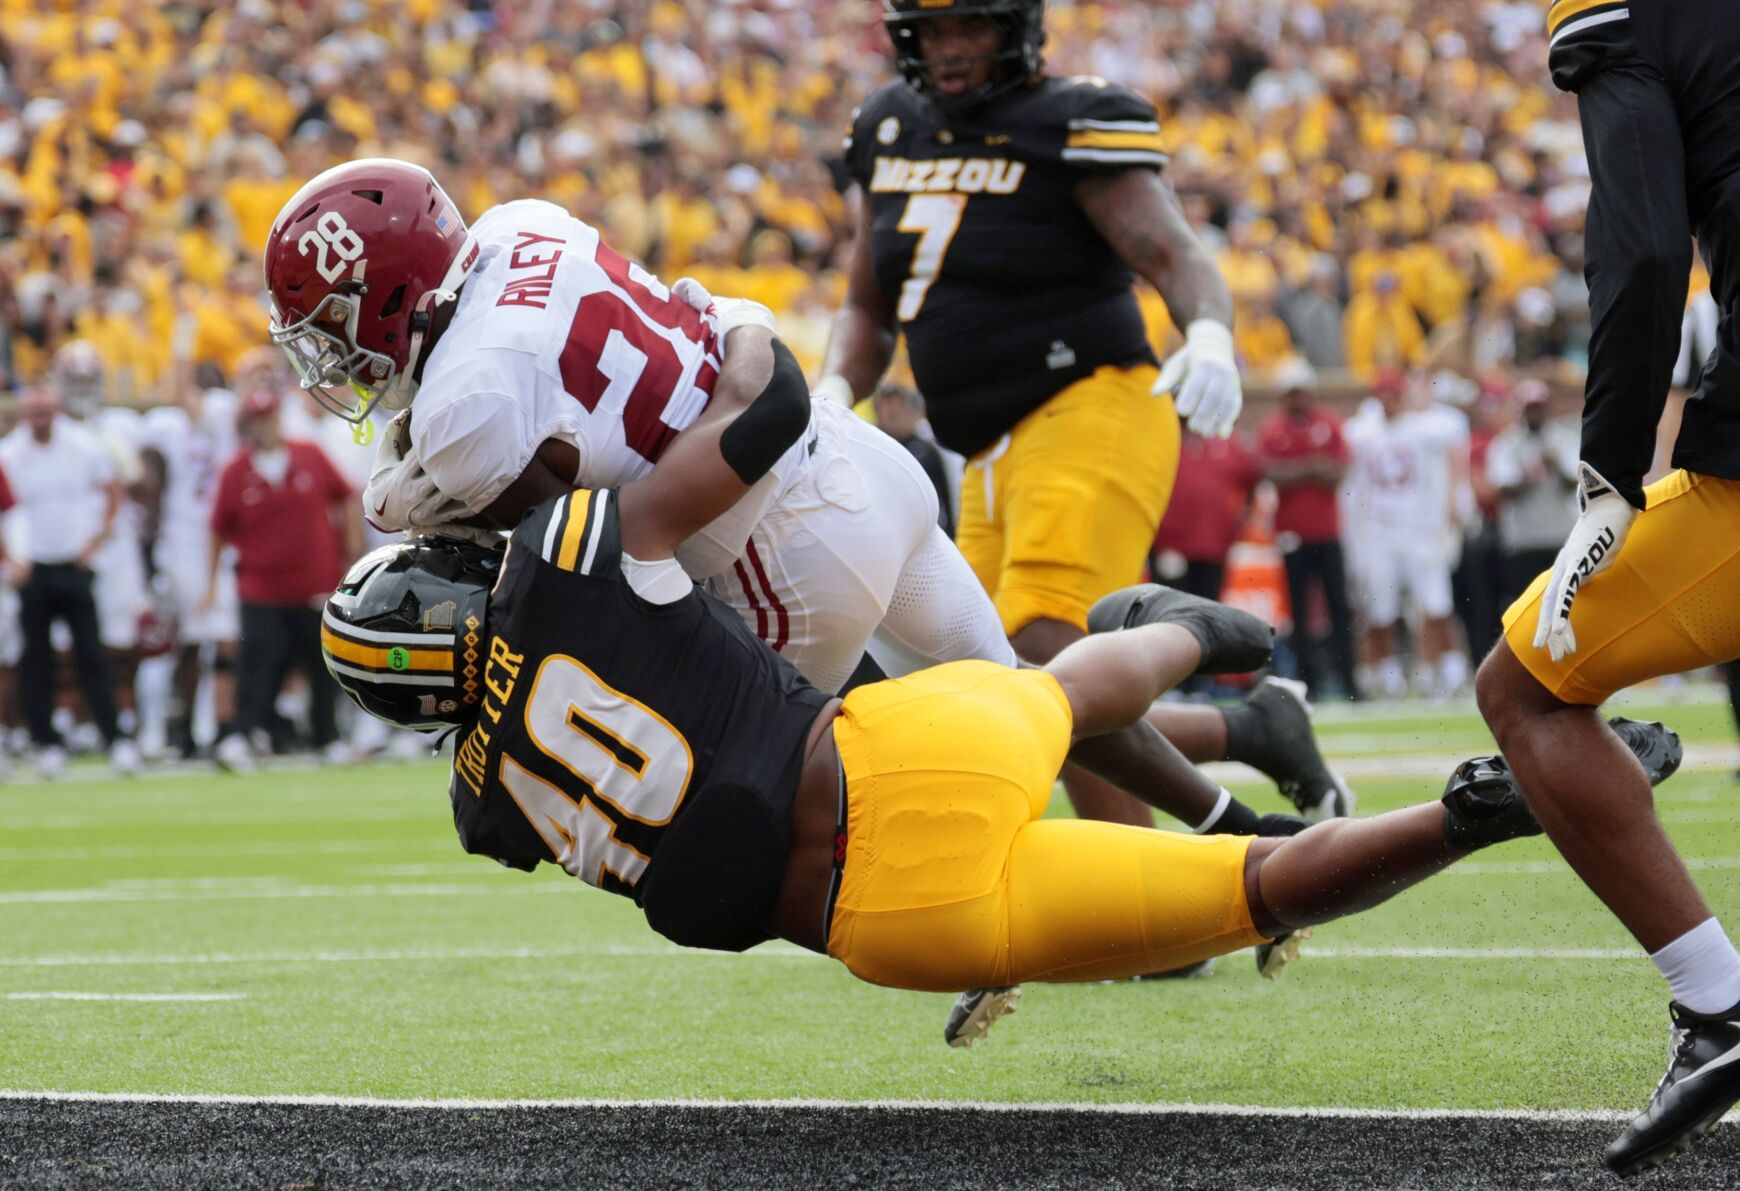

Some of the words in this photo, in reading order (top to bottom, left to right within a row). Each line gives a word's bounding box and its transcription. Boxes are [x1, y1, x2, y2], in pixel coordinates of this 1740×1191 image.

[869, 156, 1026, 194] MIZZOU
[298, 211, 364, 285] 28
[496, 232, 566, 309] RILEY
[897, 192, 968, 323] 7
[1560, 526, 1616, 621] MIZZOU
[455, 635, 525, 798] TROTTER
[499, 653, 694, 888] 40
